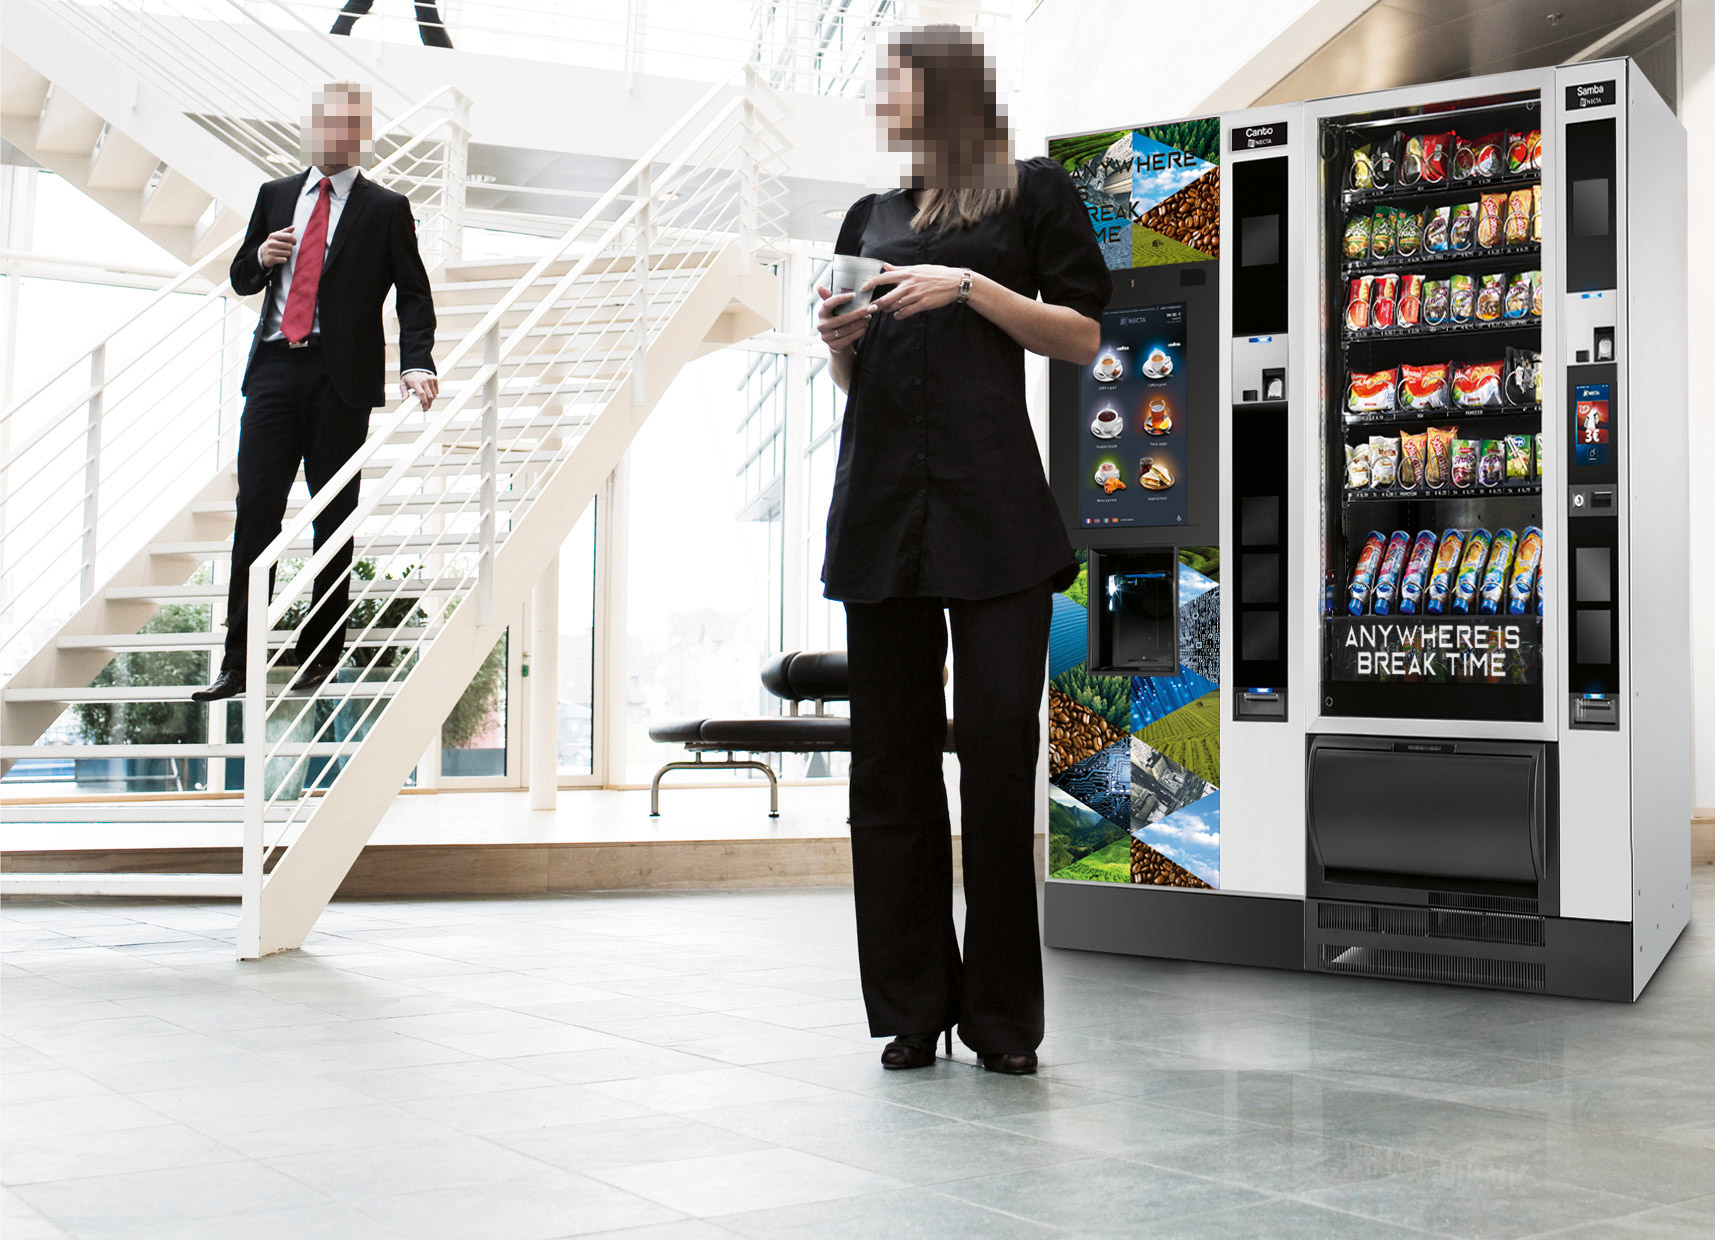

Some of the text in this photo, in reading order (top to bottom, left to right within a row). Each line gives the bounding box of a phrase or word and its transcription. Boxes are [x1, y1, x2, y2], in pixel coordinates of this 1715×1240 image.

[1577, 84, 1604, 97] Samba
[1245, 127, 1274, 138] Canto
[1071, 149, 1198, 180] ANYWHERE
[1086, 201, 1140, 223] REAK
[1585, 428, 1600, 443] 3€
[1345, 625, 1520, 649] ANYWHERE IS
[1357, 651, 1507, 677] BREAK TIME
